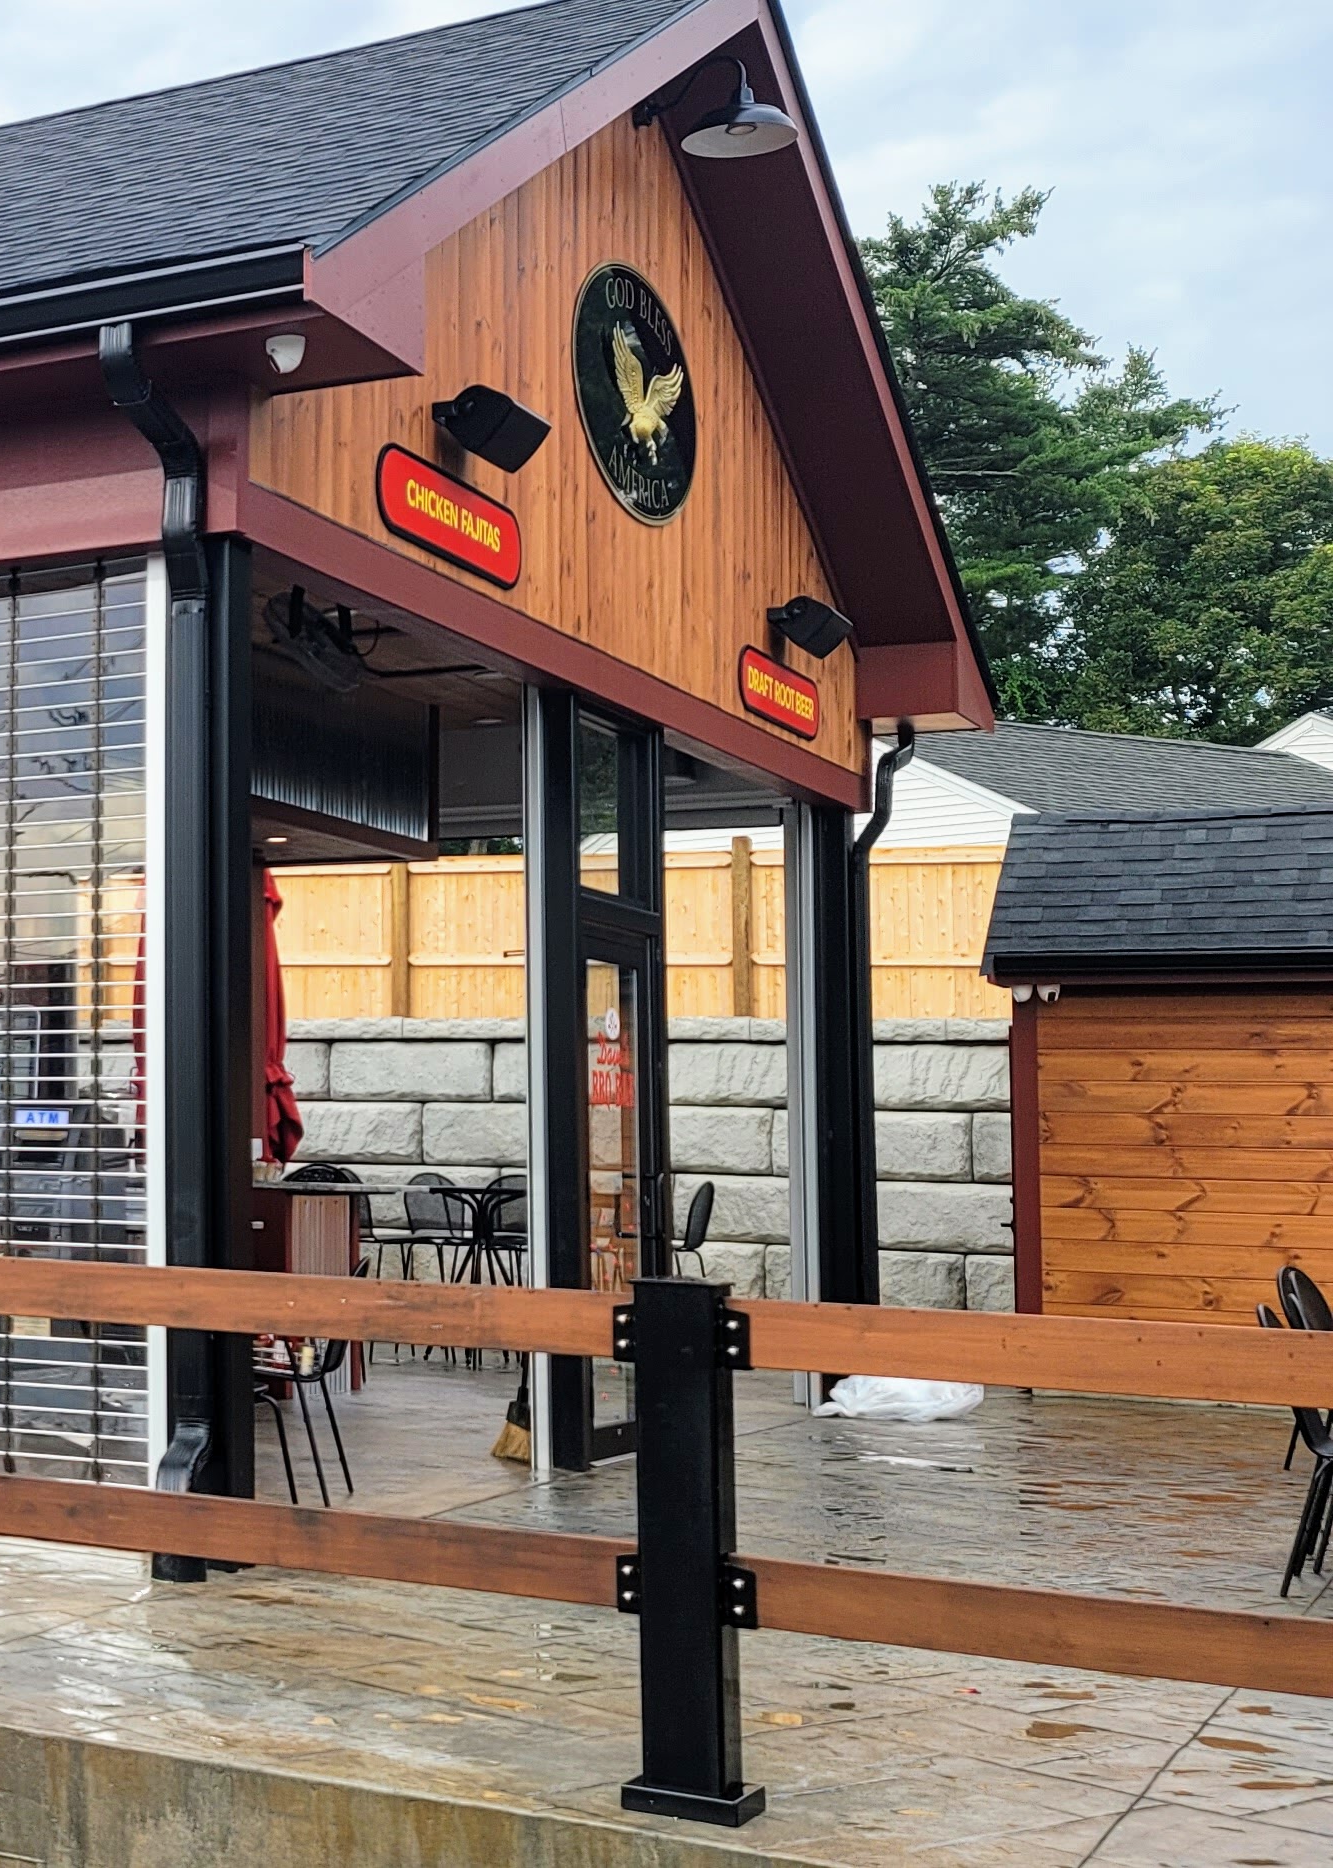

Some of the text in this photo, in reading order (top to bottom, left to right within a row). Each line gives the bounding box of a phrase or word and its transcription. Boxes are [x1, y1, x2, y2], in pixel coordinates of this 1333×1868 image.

[605, 277, 673, 356] GOD BLESS
[608, 444, 670, 509] AMERICA
[406, 478, 501, 553] CHICKEN FAJITAS
[748, 665, 815, 722] DRAFT ROOT BEER
[25, 1111, 60, 1124] ATM
